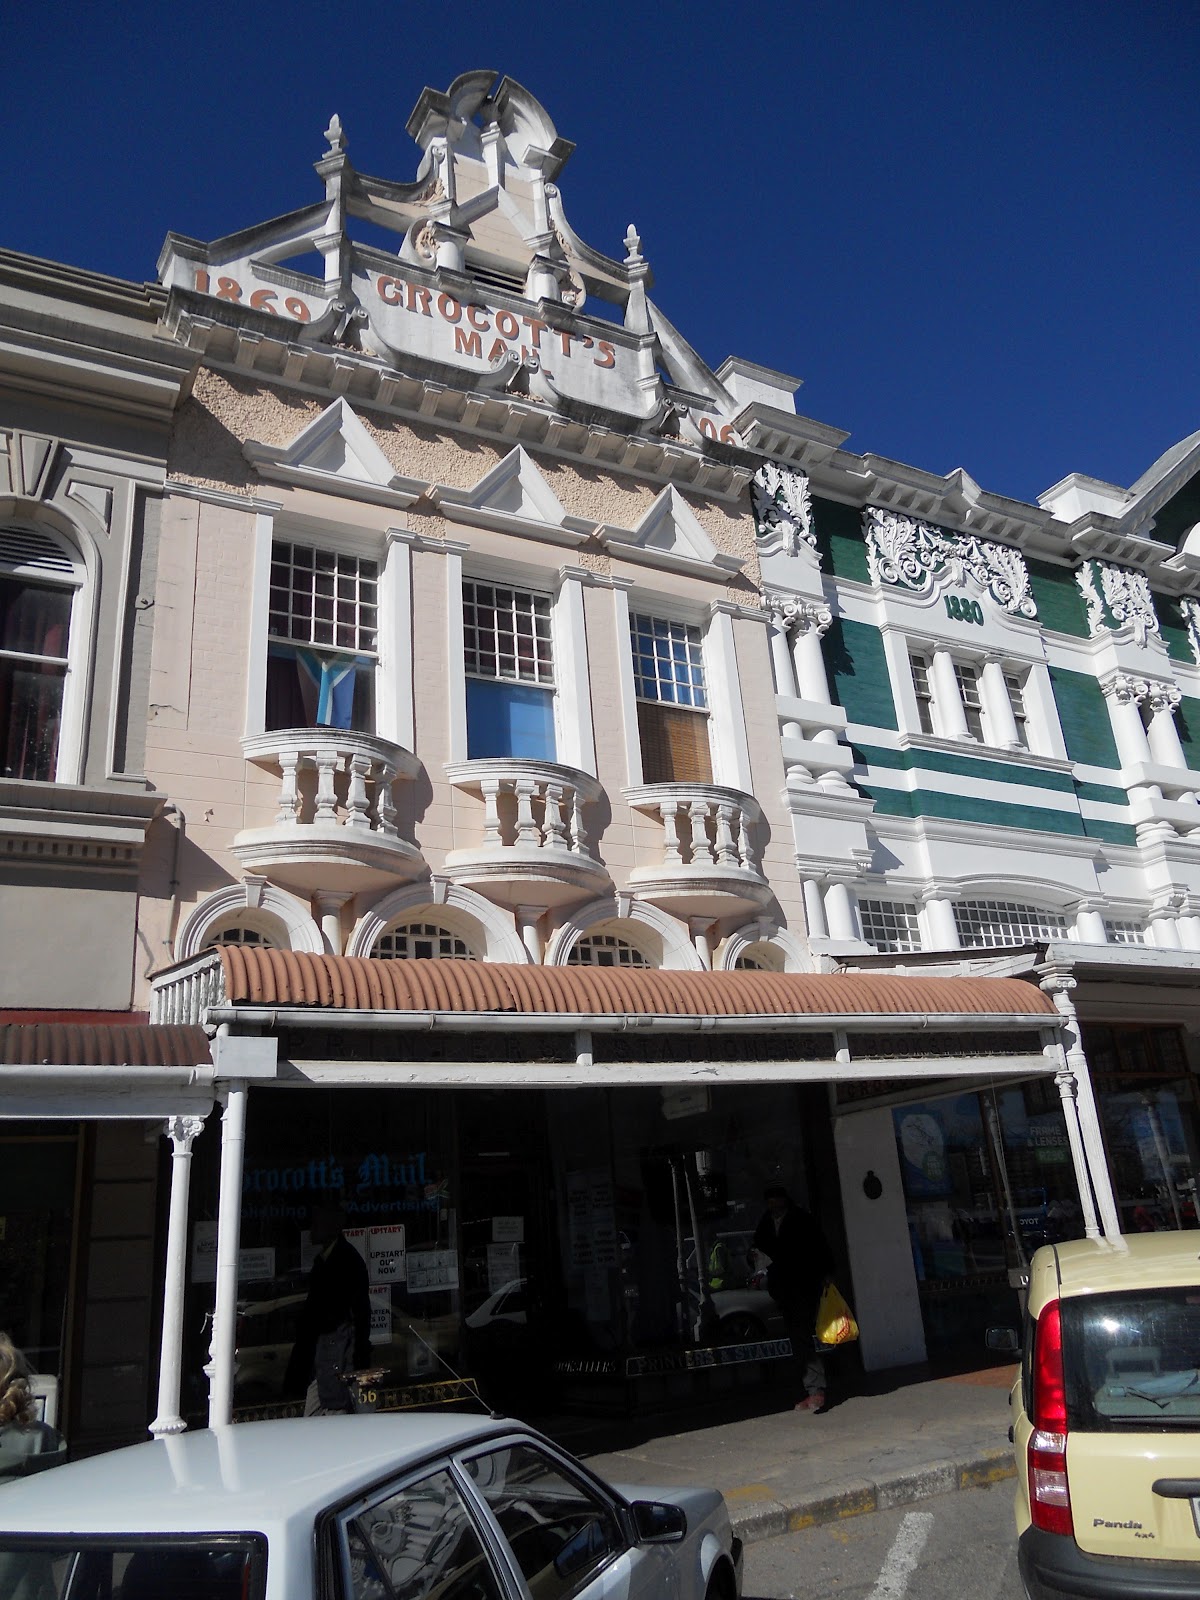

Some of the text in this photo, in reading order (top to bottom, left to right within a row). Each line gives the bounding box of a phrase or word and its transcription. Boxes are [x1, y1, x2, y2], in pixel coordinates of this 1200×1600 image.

[195, 269, 311, 322] 1869
[376, 275, 617, 369] GROCOTT'S
[240, 1152, 345, 1191] rocott's
[370, 1249, 404, 1259] UPSTART
[735, 1341, 789, 1360] STATIO
[1093, 1518, 1143, 1530] Panda
